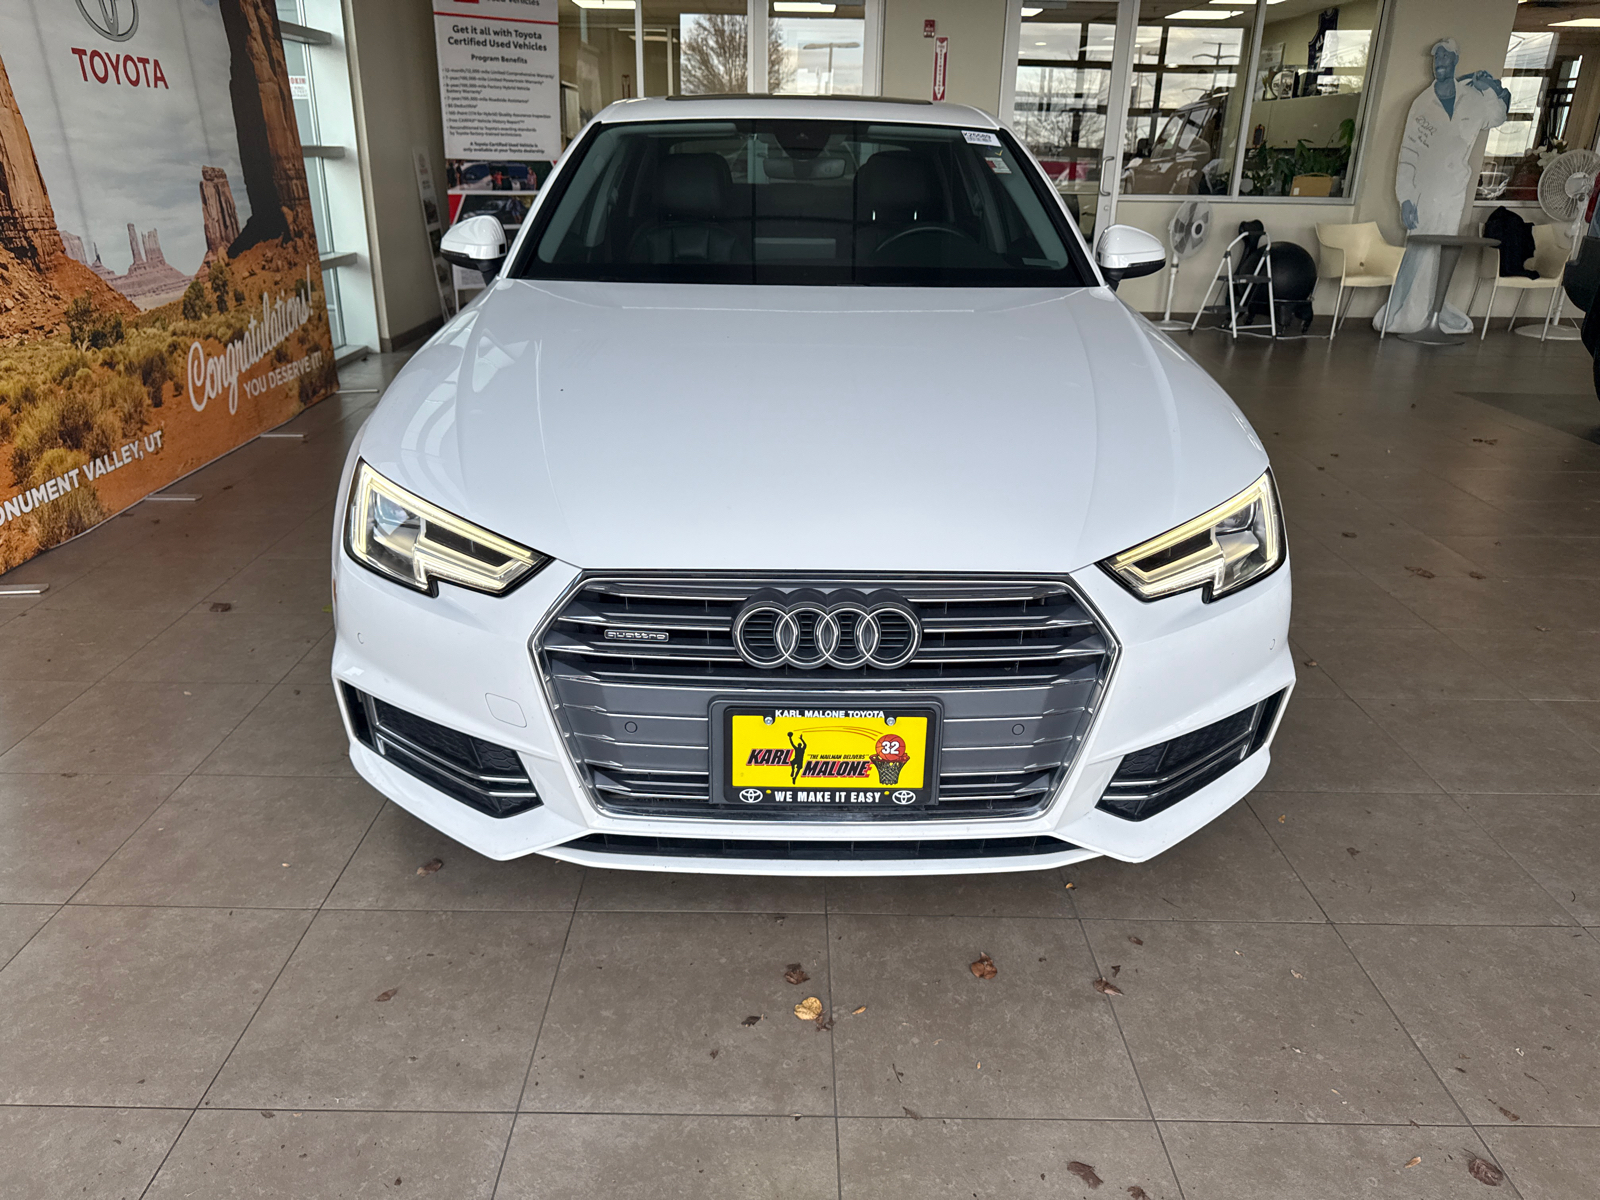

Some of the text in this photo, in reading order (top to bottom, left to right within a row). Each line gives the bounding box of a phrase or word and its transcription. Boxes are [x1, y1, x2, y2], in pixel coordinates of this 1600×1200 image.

[452, 24, 542, 40] Get it all with Toyota
[447, 36, 547, 51] Certified Used Vehicles
[470, 53, 500, 63] Program
[71, 47, 169, 90] TOYOTA
[188, 263, 314, 415] Congratulations!
[243, 350, 323, 399] YOU DESERVE IT!
[0, 430, 162, 527] NUMENT VALLEY, UT
[607, 631, 666, 640] quattro
[775, 709, 885, 719] KARL MALONE TOYOTA
[881, 741, 900, 755] 32
[746, 748, 794, 766] KARL
[801, 760, 873, 778] MALONE
[774, 791, 881, 803] WE MAKE IT EASY
